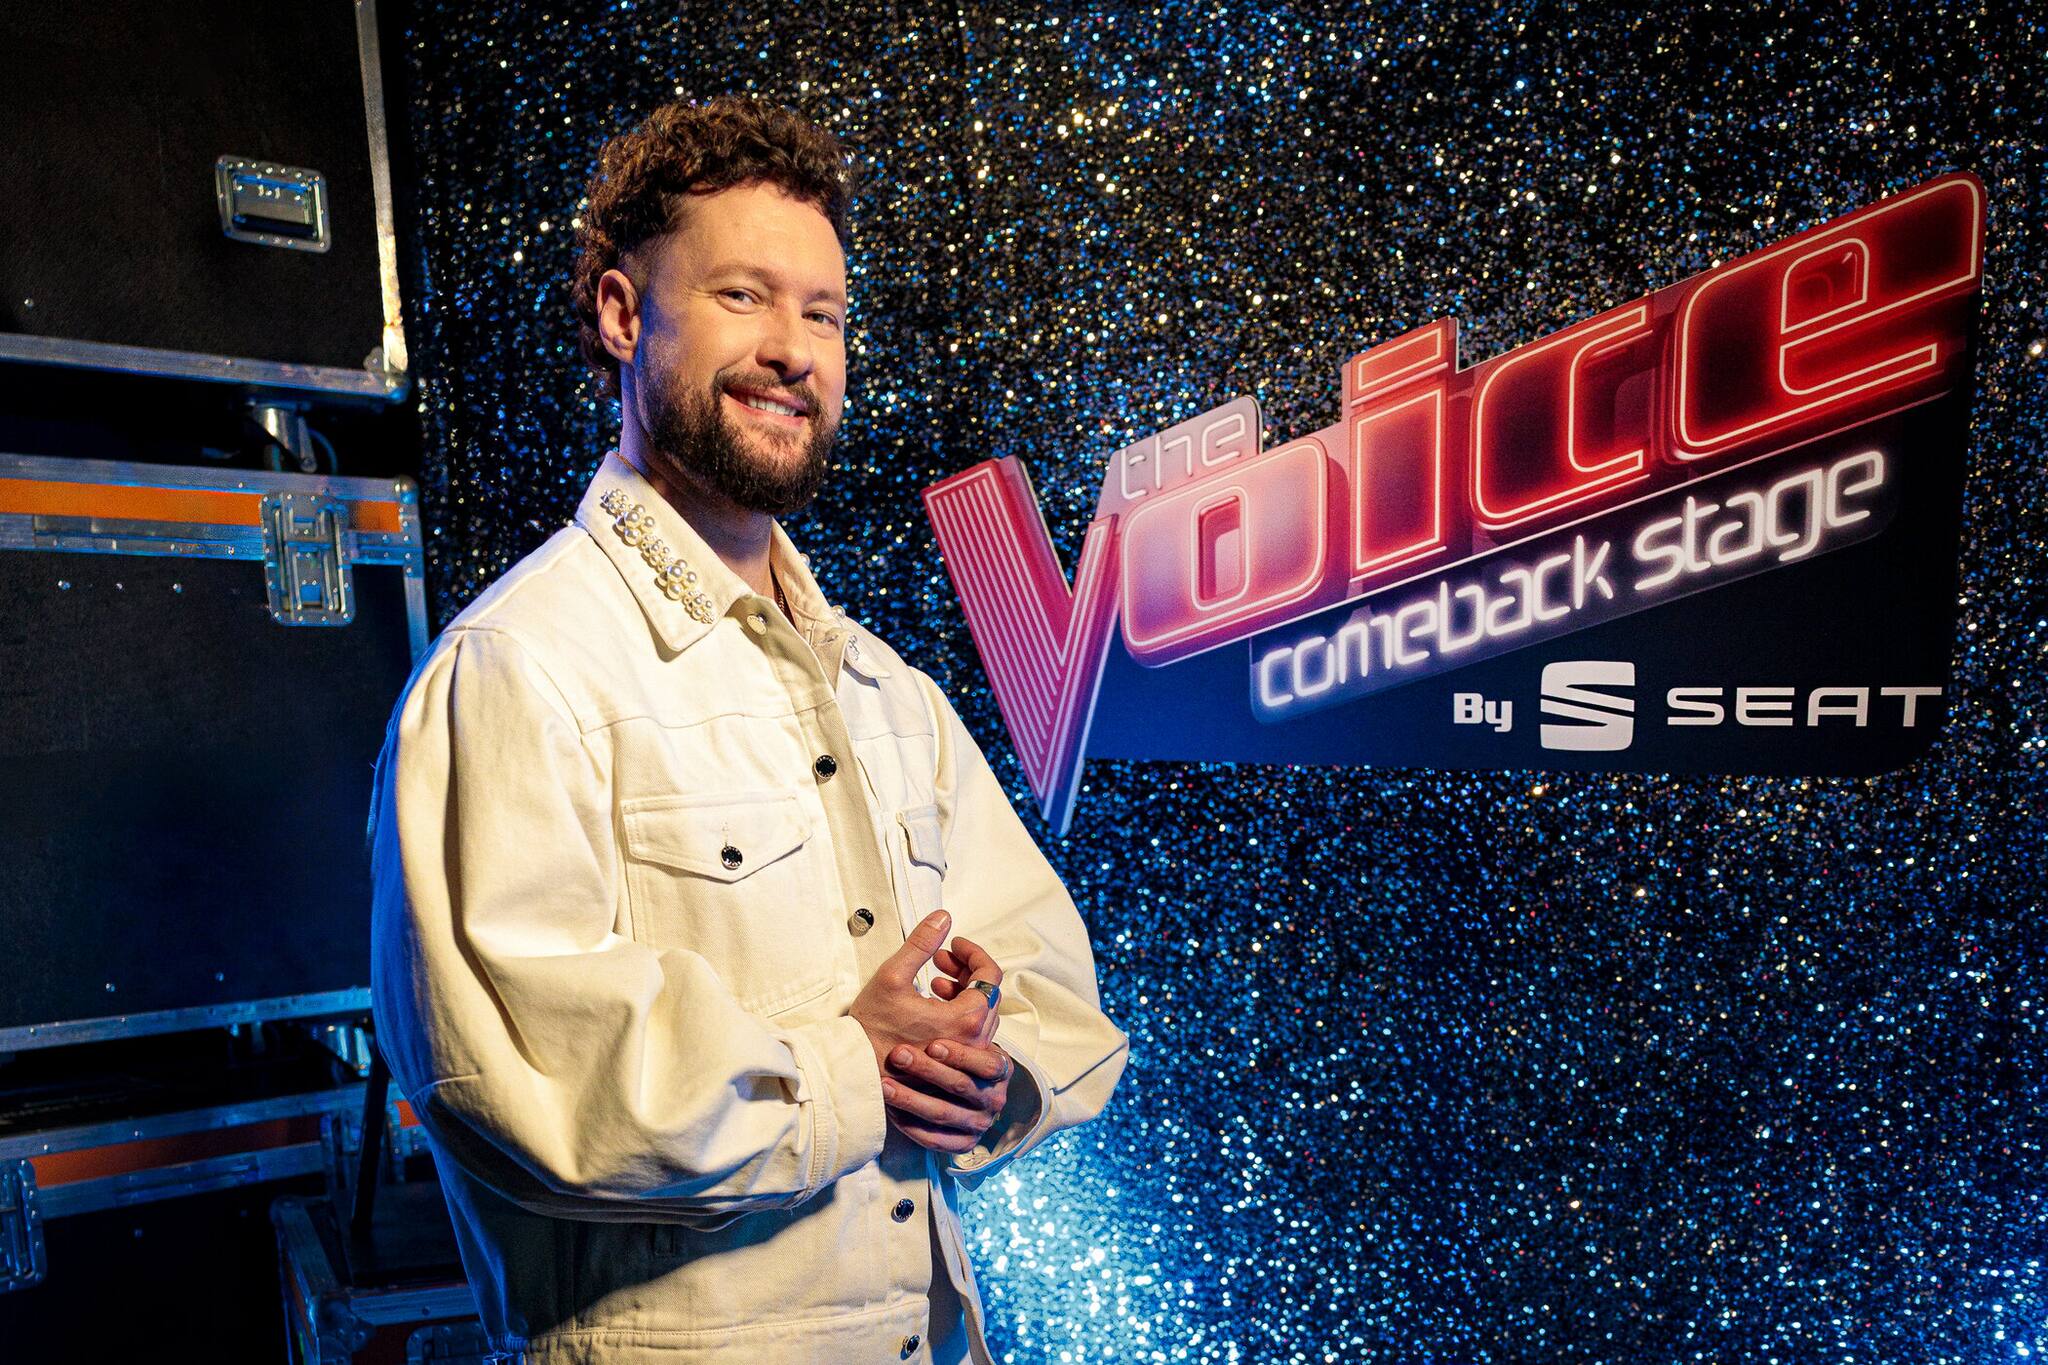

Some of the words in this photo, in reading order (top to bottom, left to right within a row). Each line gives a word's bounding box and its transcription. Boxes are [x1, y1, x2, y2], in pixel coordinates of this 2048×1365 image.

[924, 172, 1985, 822] Voice
[1120, 412, 1247, 500] the
[1259, 534, 1614, 709] comeback
[1633, 450, 1885, 591] stage
[1453, 692, 1513, 733] By
[1666, 686, 1943, 728] SEAT
